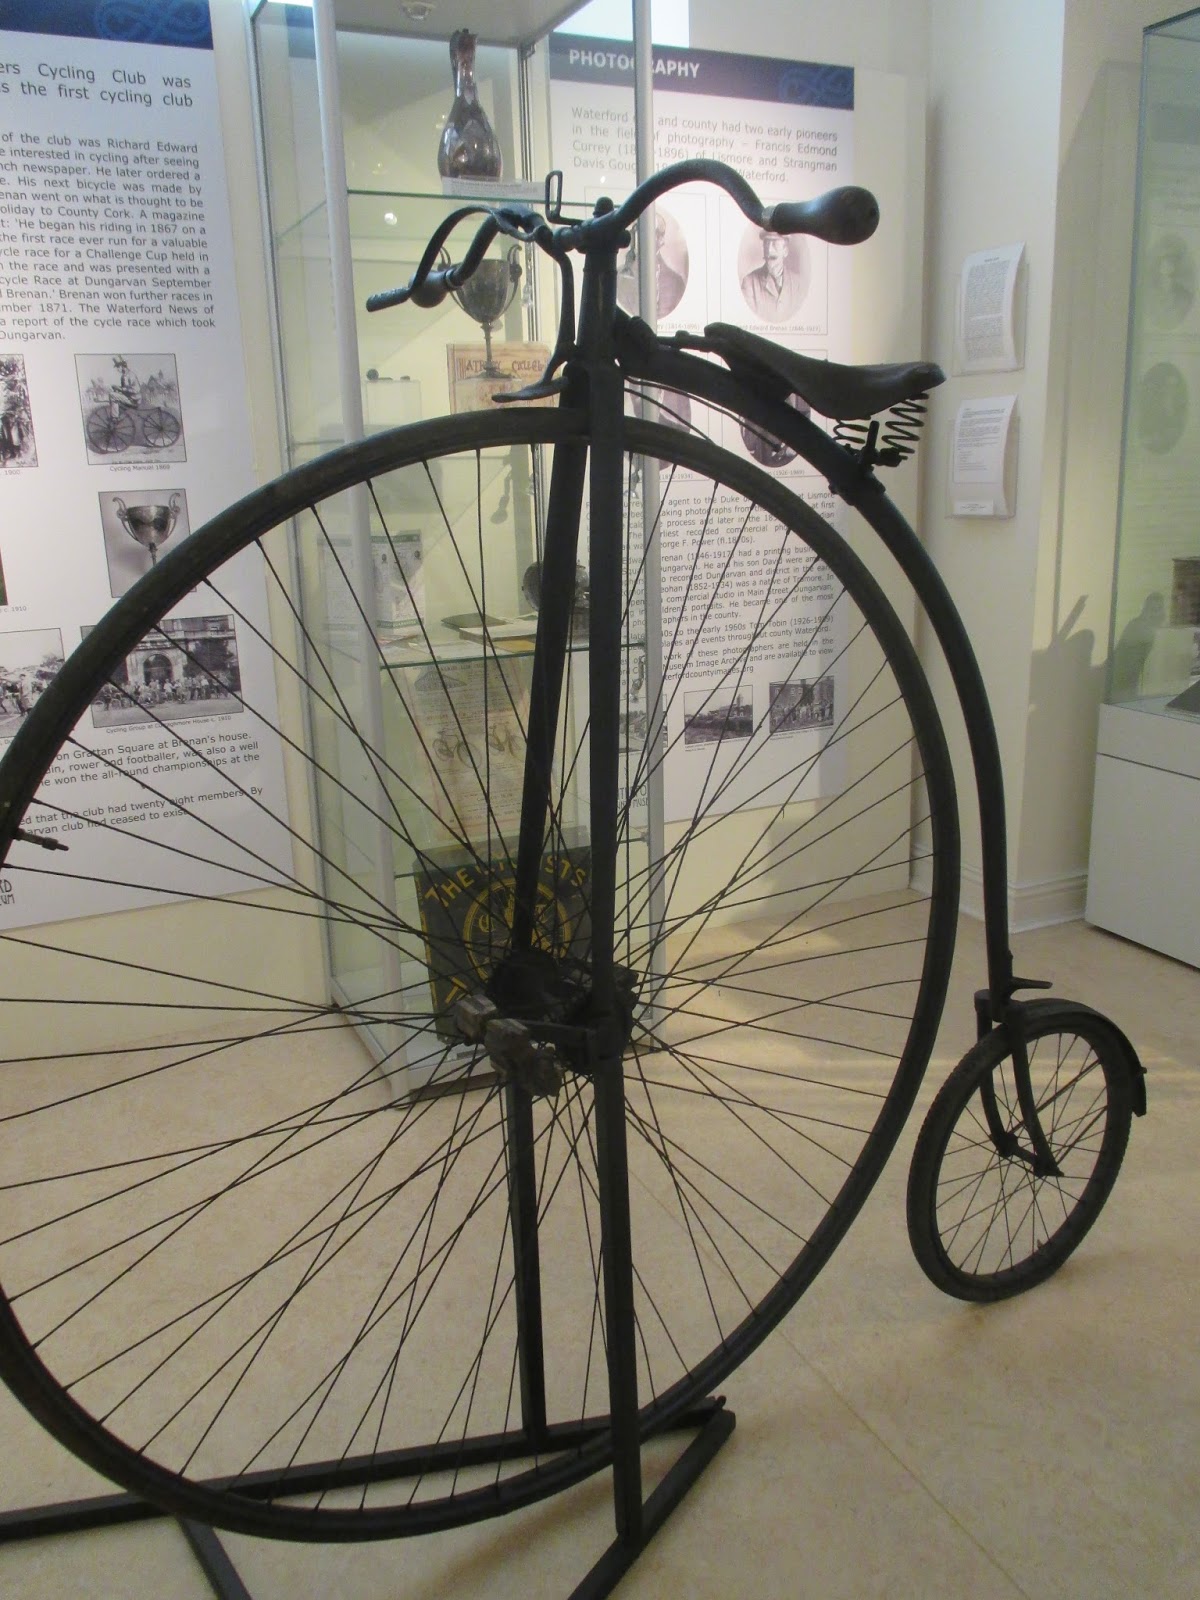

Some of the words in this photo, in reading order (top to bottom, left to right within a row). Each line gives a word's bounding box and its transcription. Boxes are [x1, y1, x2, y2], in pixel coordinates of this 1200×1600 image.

[569, 50, 700, 78] PHOTOAPHY
[38, 63, 95, 83] Cycling
[112, 70, 146, 85] Club
[163, 77, 191, 88] was
[21, 82, 47, 95] the
[58, 85, 89, 99] first
[100, 90, 151, 107] cycling
[163, 94, 193, 107] club
[572, 107, 628, 121] Waterford
[658, 116, 677, 126] and
[682, 119, 717, 132] county
[722, 121, 740, 132] had
[745, 125, 763, 134] two
[768, 126, 792, 140] early
[796, 129, 837, 142] pioneers
[21, 134, 40, 144] the
[47, 135, 71, 146] club
[79, 139, 100, 147] was
[107, 139, 150, 150] Richard
[157, 142, 198, 153] Edward
[591, 126, 608, 137] the
[668, 131, 735, 148] photography
[756, 140, 791, 152] Francis
[798, 144, 836, 156] Edmond
[10, 149, 70, 160] interested
[89, 153, 128, 165] cycling
[133, 154, 158, 165] after
[164, 158, 199, 169] seeing
[572, 141, 611, 154] Currey
[759, 156, 777, 166] and
[784, 157, 837, 172] Strangman
[574, 156, 604, 169] Davis
[23, 164, 90, 175] newspaper.
[116, 168, 142, 178] later
[147, 170, 189, 180] ordered
[18, 177, 36, 186] His
[44, 180, 69, 188] next
[77, 180, 116, 192] bicycle
[151, 184, 182, 193] made
[31, 193, 59, 202] went
[83, 194, 111, 204] what
[128, 197, 171, 208] thought
[58, 207, 98, 219] County
[104, 209, 133, 218] Cork.
[152, 211, 204, 222] magazine
[39, 220, 75, 231] began
[79, 222, 95, 231] his
[100, 222, 132, 233] riding
[151, 225, 176, 233] 1867
[22, 234, 44, 243] first
[50, 236, 74, 244] race
[132, 236, 147, 246] for
[162, 239, 207, 248] valuable
[54, 248, 70, 258] for
[87, 249, 141, 260] Challenge
[146, 251, 167, 262] Cup
[172, 252, 194, 261] held
[9, 262, 28, 270] the
[64, 263, 84, 272] and
[117, 264, 171, 274] presented
[177, 265, 199, 274] with
[34, 276, 61, 285] Race
[85, 276, 146, 288] Dungarvan
[152, 279, 211, 289] September
[59, 290, 99, 299] Brenan
[104, 292, 125, 300] won
[130, 291, 168, 301] further
[172, 293, 199, 301] races
[40, 304, 72, 313] 1871.
[79, 304, 100, 313] The
[107, 304, 162, 314] Waterford
[169, 305, 197, 314] News
[12, 317, 48, 327] report
[70, 317, 88, 326] the
[94, 318, 121, 328] cycle
[156, 318, 187, 327] which
[192, 318, 215, 327] took
[110, 465, 131, 473] Cycling
[669, 499, 690, 507] agent
[686, 506, 732, 516] photographs
[667, 520, 695, 528] process
[726, 525, 767, 533] commercial
[764, 547, 791, 555] printing
[750, 568, 765, 576] and
[766, 566, 790, 575] district
[667, 593, 709, 602] commercial
[703, 626, 720, 634] early
[777, 650, 807, 659] available
[74, 747, 113, 759] Grattan
[117, 742, 155, 755] Square
[219, 732, 252, 742] house.
[69, 761, 100, 771] rower
[127, 752, 179, 765] footballer,
[206, 745, 226, 755] also
[239, 742, 259, 751] well
[55, 774, 77, 785] won
[81, 771, 98, 782] the
[152, 757, 228, 773] championships
[243, 753, 260, 762] the
[35, 812, 58, 823] that
[83, 805, 104, 817] club
[108, 804, 127, 814] had
[131, 799, 166, 813] twenty
[62, 821, 84, 832] club
[110, 813, 145, 826] ceased
[424, 868, 474, 908] THE
